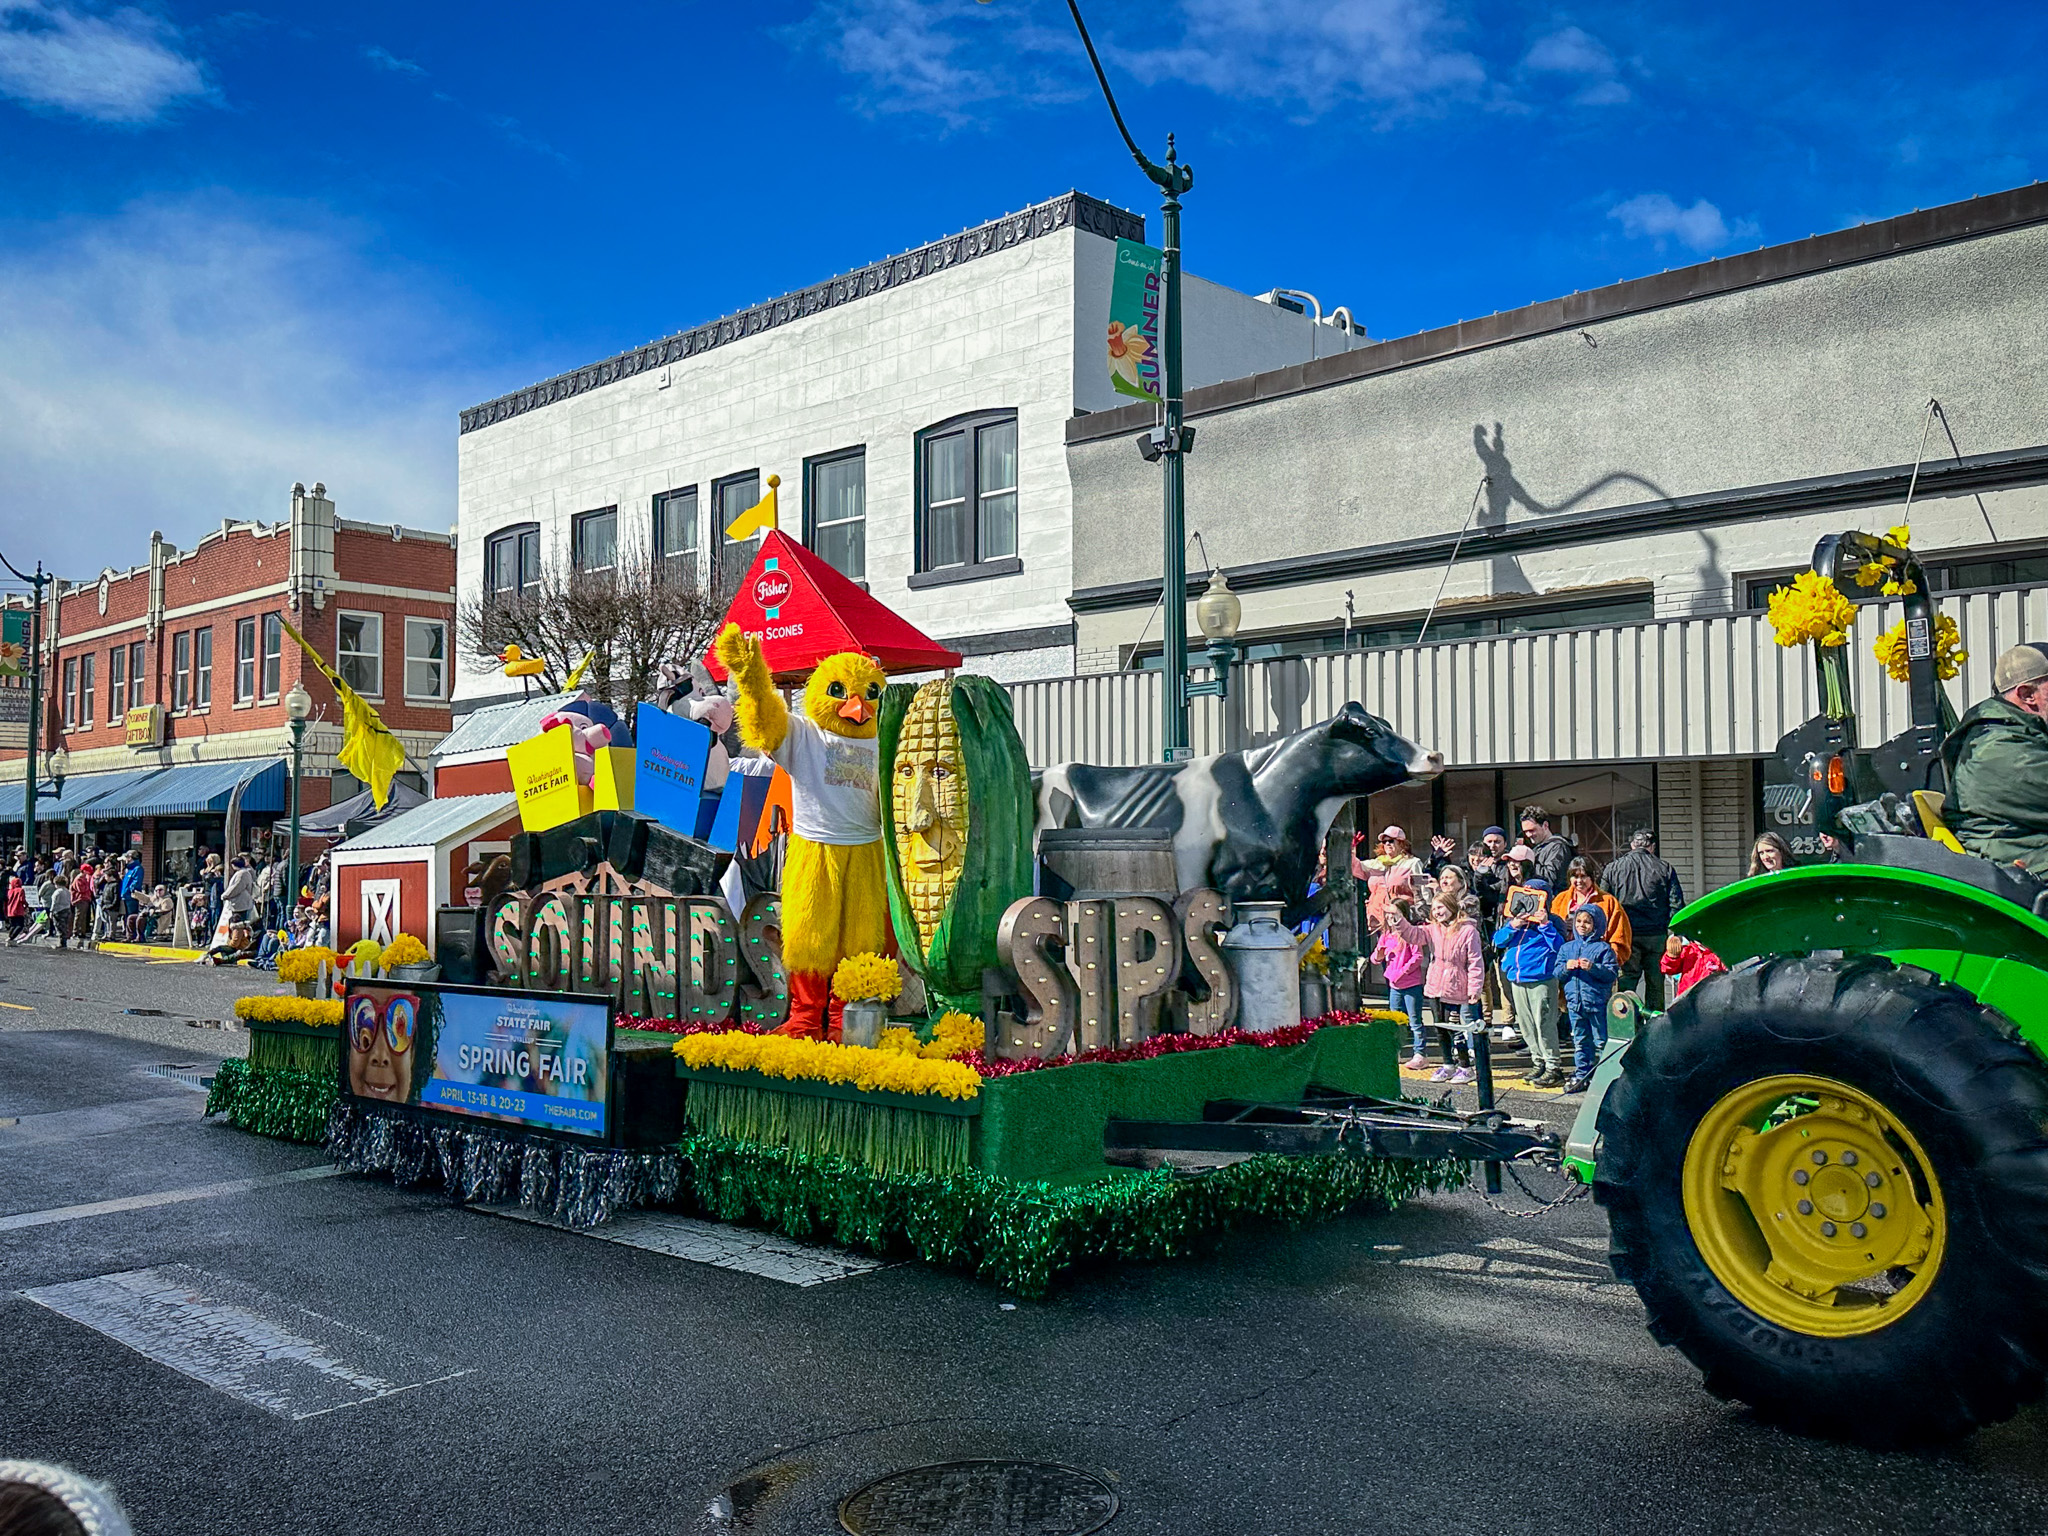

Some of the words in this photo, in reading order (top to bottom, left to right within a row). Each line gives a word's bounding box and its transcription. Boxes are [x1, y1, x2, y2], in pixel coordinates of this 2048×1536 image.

[1142, 272, 1161, 396] SUMNER
[757, 579, 789, 602] Fisher
[20, 619, 31, 672] SUMNER
[523, 782, 549, 799] STATE
[550, 774, 569, 788] FAIR
[644, 759, 672, 778] STATE
[673, 770, 695, 787] FAIR
[485, 891, 788, 1025] SOUNDS
[997, 887, 1238, 1062] SIPS
[496, 1015, 526, 1029] STATE
[528, 1018, 551, 1032] FAIR
[459, 1045, 530, 1076] SPRING
[539, 1054, 587, 1085] FAIR
[440, 1086, 466, 1103] APRIL
[467, 1090, 489, 1107] 13-16
[490, 1094, 497, 1108] &
[498, 1096, 526, 1113] 20-23
[543, 1103, 598, 1121] THEFAIR.COM
